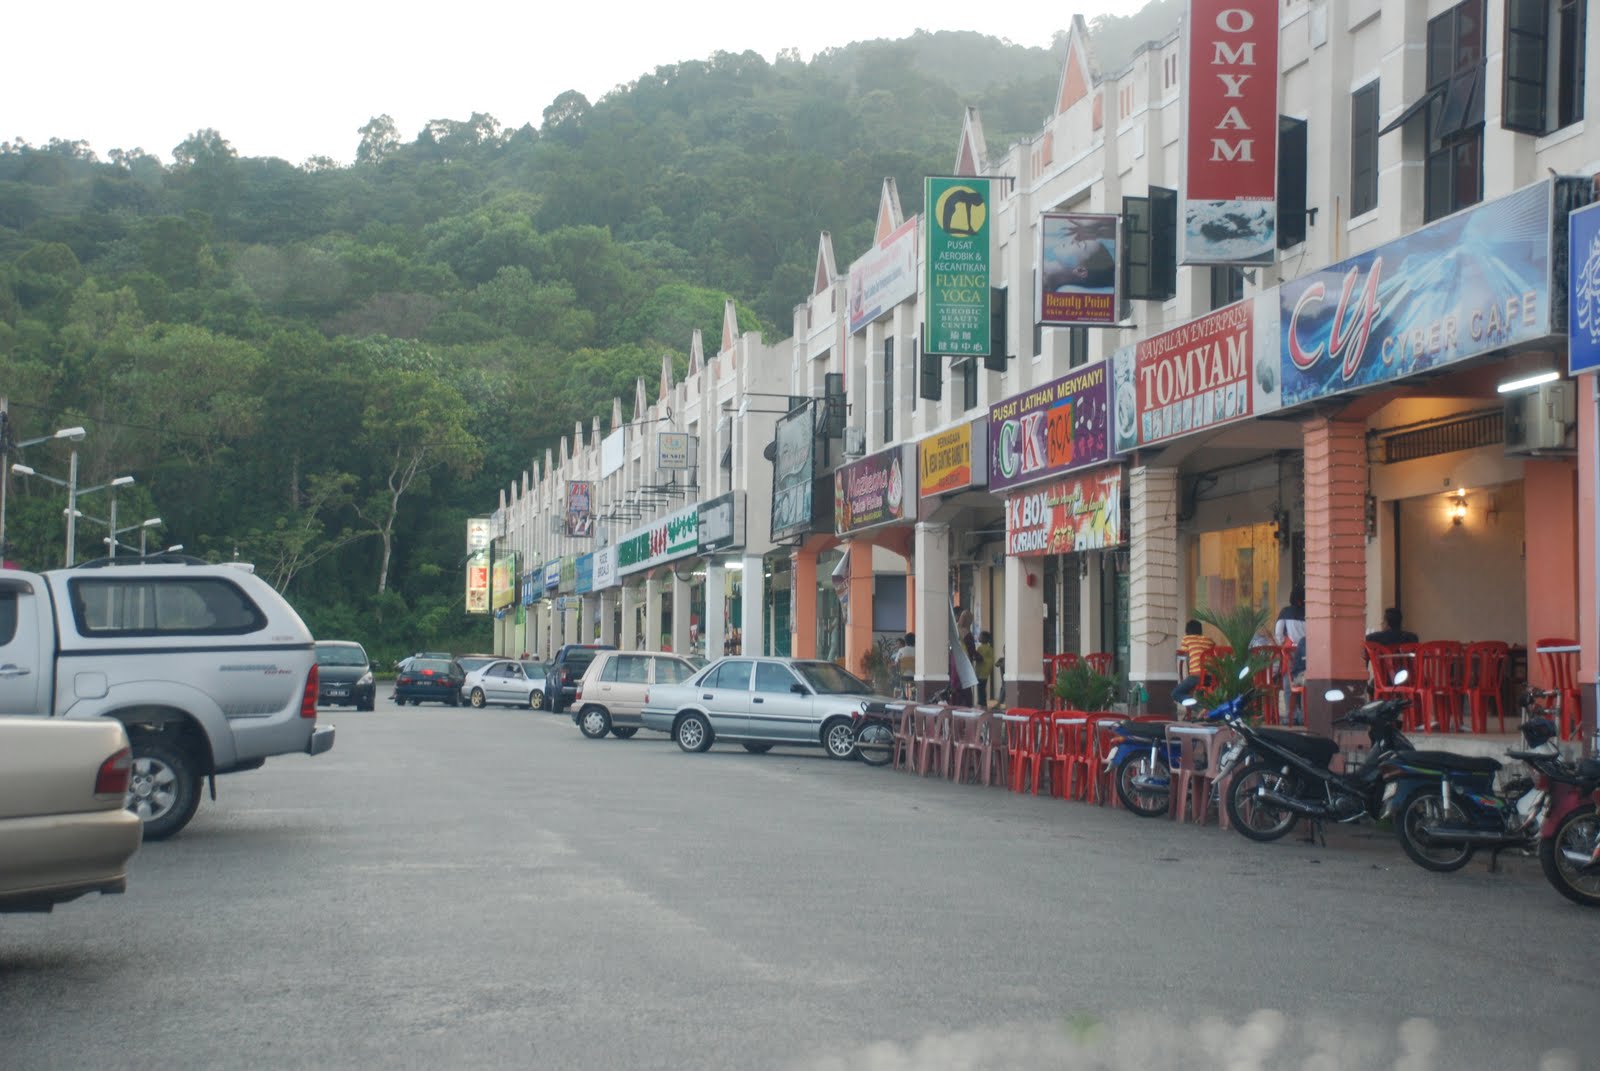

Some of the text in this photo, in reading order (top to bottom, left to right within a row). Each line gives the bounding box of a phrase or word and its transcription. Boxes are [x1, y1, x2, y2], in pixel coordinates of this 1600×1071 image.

[939, 251, 982, 261] AEROBIK &
[947, 240, 973, 249] PUSAT
[934, 262, 986, 272] KECANTIKAN
[935, 273, 985, 288] FLYING
[941, 289, 981, 303] YOGA
[1046, 293, 1110, 309] Beauty Point
[1190, 304, 1248, 341] ENTERPRISE
[1381, 289, 1537, 366] CYBER CAFE
[1141, 330, 1248, 410] TOMYAM
[993, 368, 1103, 422] PUSAT LATIHAN MENYANYI
[1000, 411, 1047, 479] CK
[1022, 492, 1049, 528] BOX
[1011, 531, 1048, 554] KARAOKE
